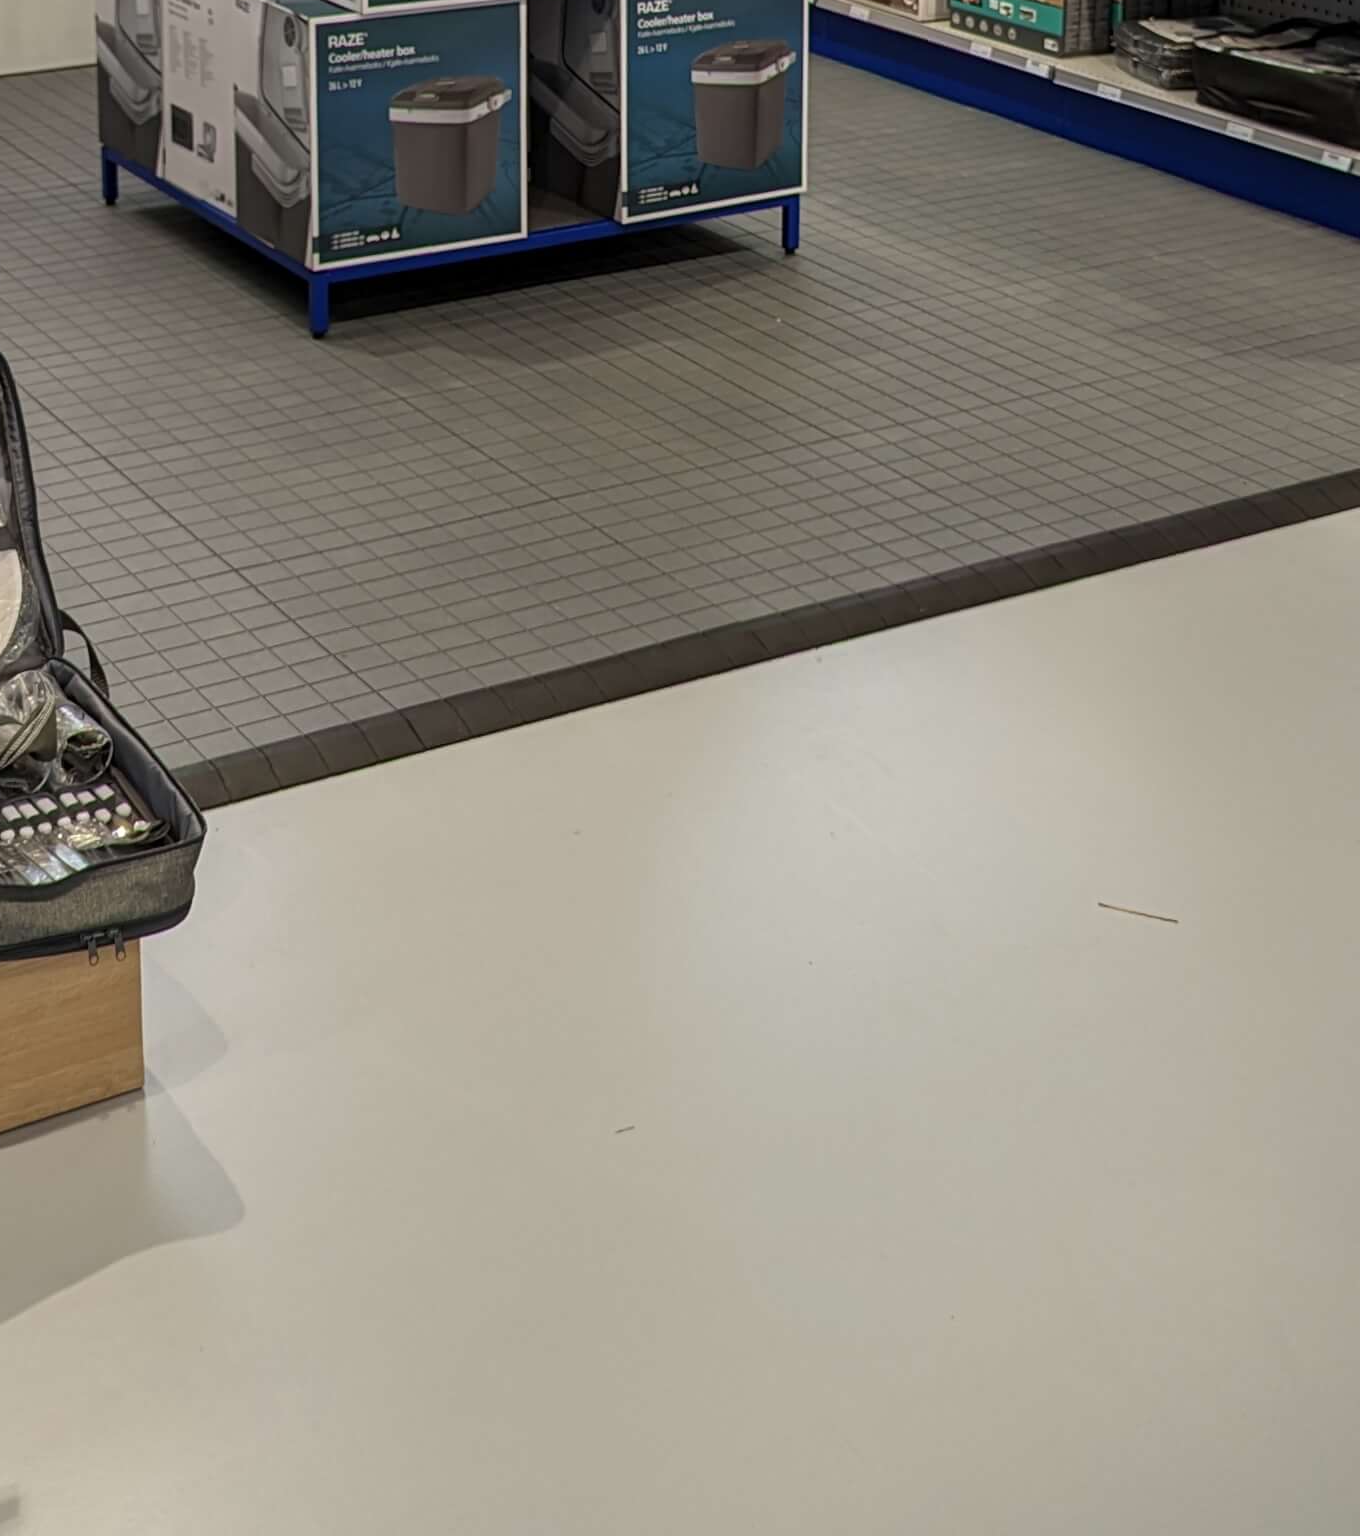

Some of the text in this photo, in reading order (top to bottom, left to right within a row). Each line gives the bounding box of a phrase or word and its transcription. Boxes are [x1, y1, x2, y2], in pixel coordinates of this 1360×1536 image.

[637, 0, 672, 15] RAZE
[697, 11, 714, 22] box
[328, 32, 368, 49] RAZE
[396, 45, 416, 56] box
